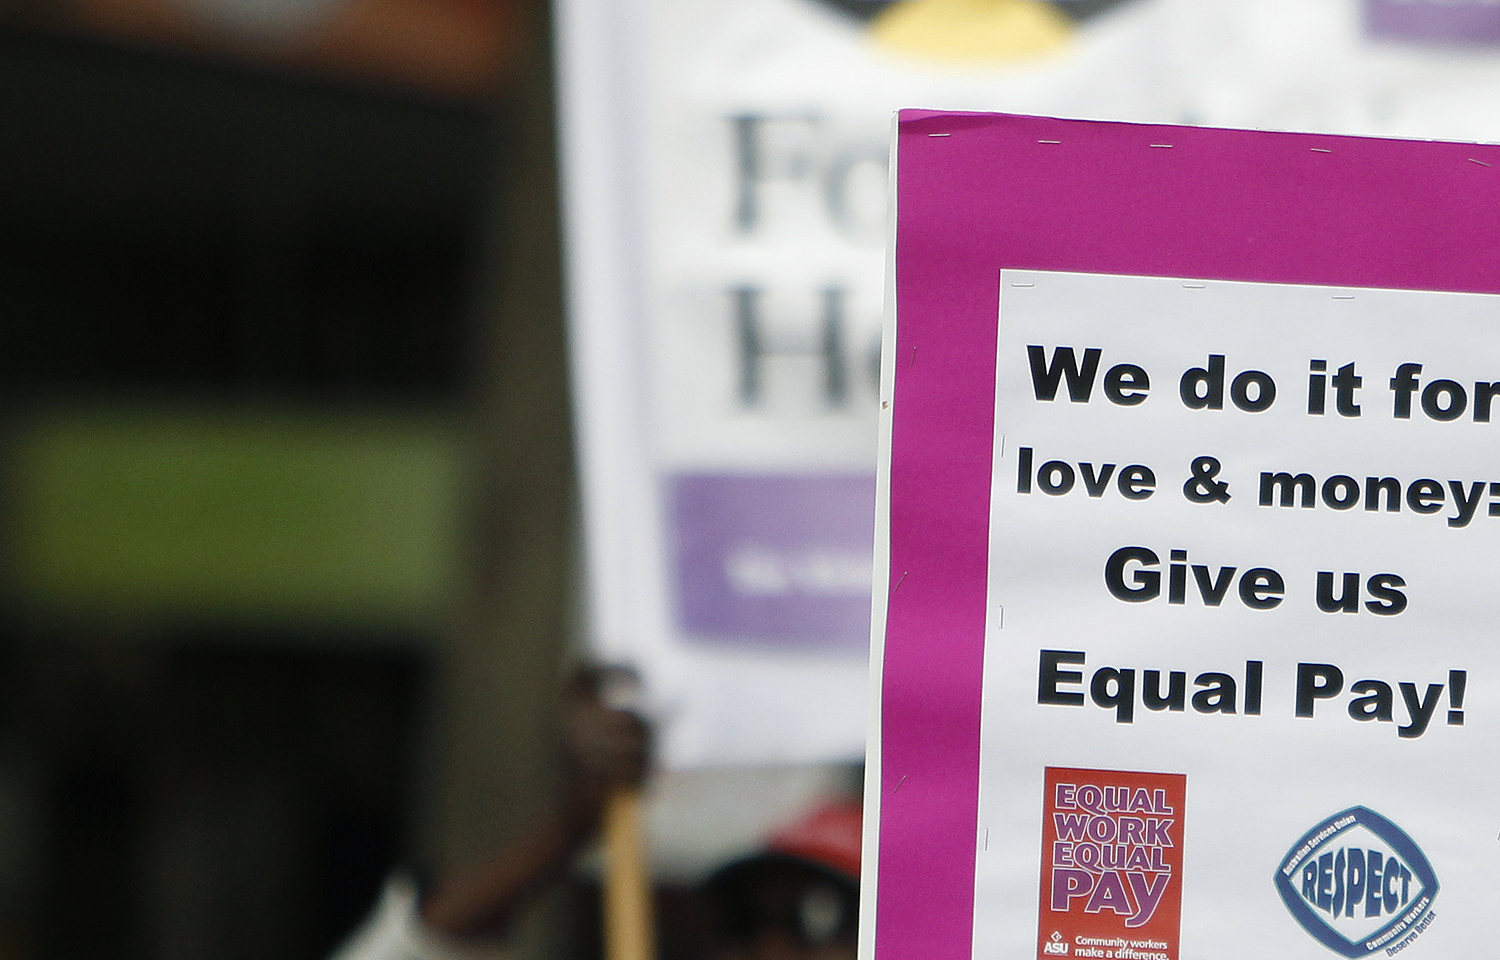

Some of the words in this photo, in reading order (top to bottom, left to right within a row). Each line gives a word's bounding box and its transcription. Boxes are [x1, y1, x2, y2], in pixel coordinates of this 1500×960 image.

[1026, 344, 1150, 406] We
[1179, 354, 1277, 413] do
[1307, 359, 1363, 418] it
[1017, 447, 1156, 500] love
[1183, 455, 1232, 504] &
[1104, 546, 1285, 610] Give
[1316, 571, 1408, 616] us
[1037, 649, 1263, 724] Equal
[1295, 662, 1467, 739] Pay!
[1055, 783, 1173, 815] EQUAL
[1053, 813, 1174, 847] WORK
[1307, 825, 1337, 848] Services
[1053, 841, 1172, 874] EQUAL
[1301, 846, 1413, 920] RESPECT
[1044, 942, 1069, 954] ASU
[1075, 936, 1128, 949] Community
[1130, 940, 1168, 950] workers
[1365, 921, 1407, 951] Community
[1386, 931, 1418, 957] Deserve
[1414, 910, 1437, 935] Better
[1075, 947, 1104, 958] make
[1106, 950, 1113, 959] a
